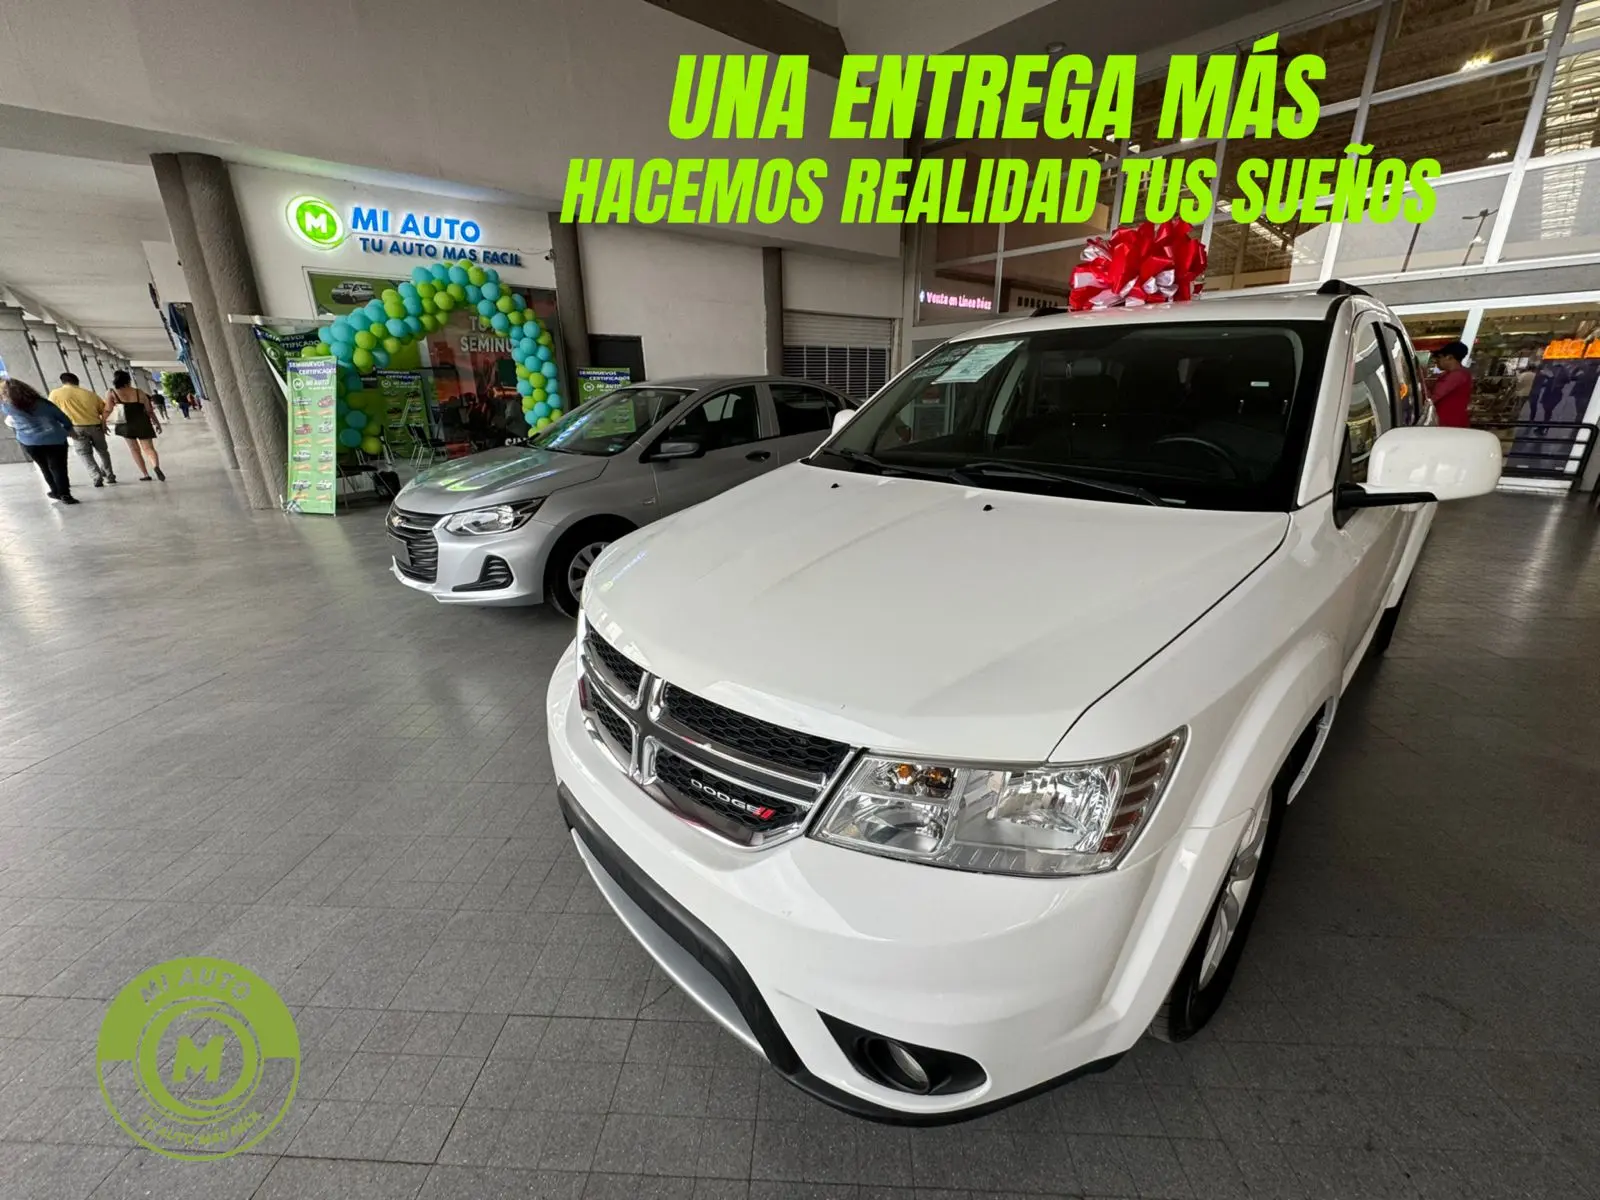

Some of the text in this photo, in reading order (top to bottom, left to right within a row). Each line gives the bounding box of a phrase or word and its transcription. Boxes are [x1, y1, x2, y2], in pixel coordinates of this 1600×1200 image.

[304, 211, 328, 233] M
[352, 207, 481, 243] MI AUTO
[359, 237, 522, 267] TU AUTO MAS FACIL
[460, 336, 514, 353] SEMINU
[690, 778, 759, 813] DODGE
